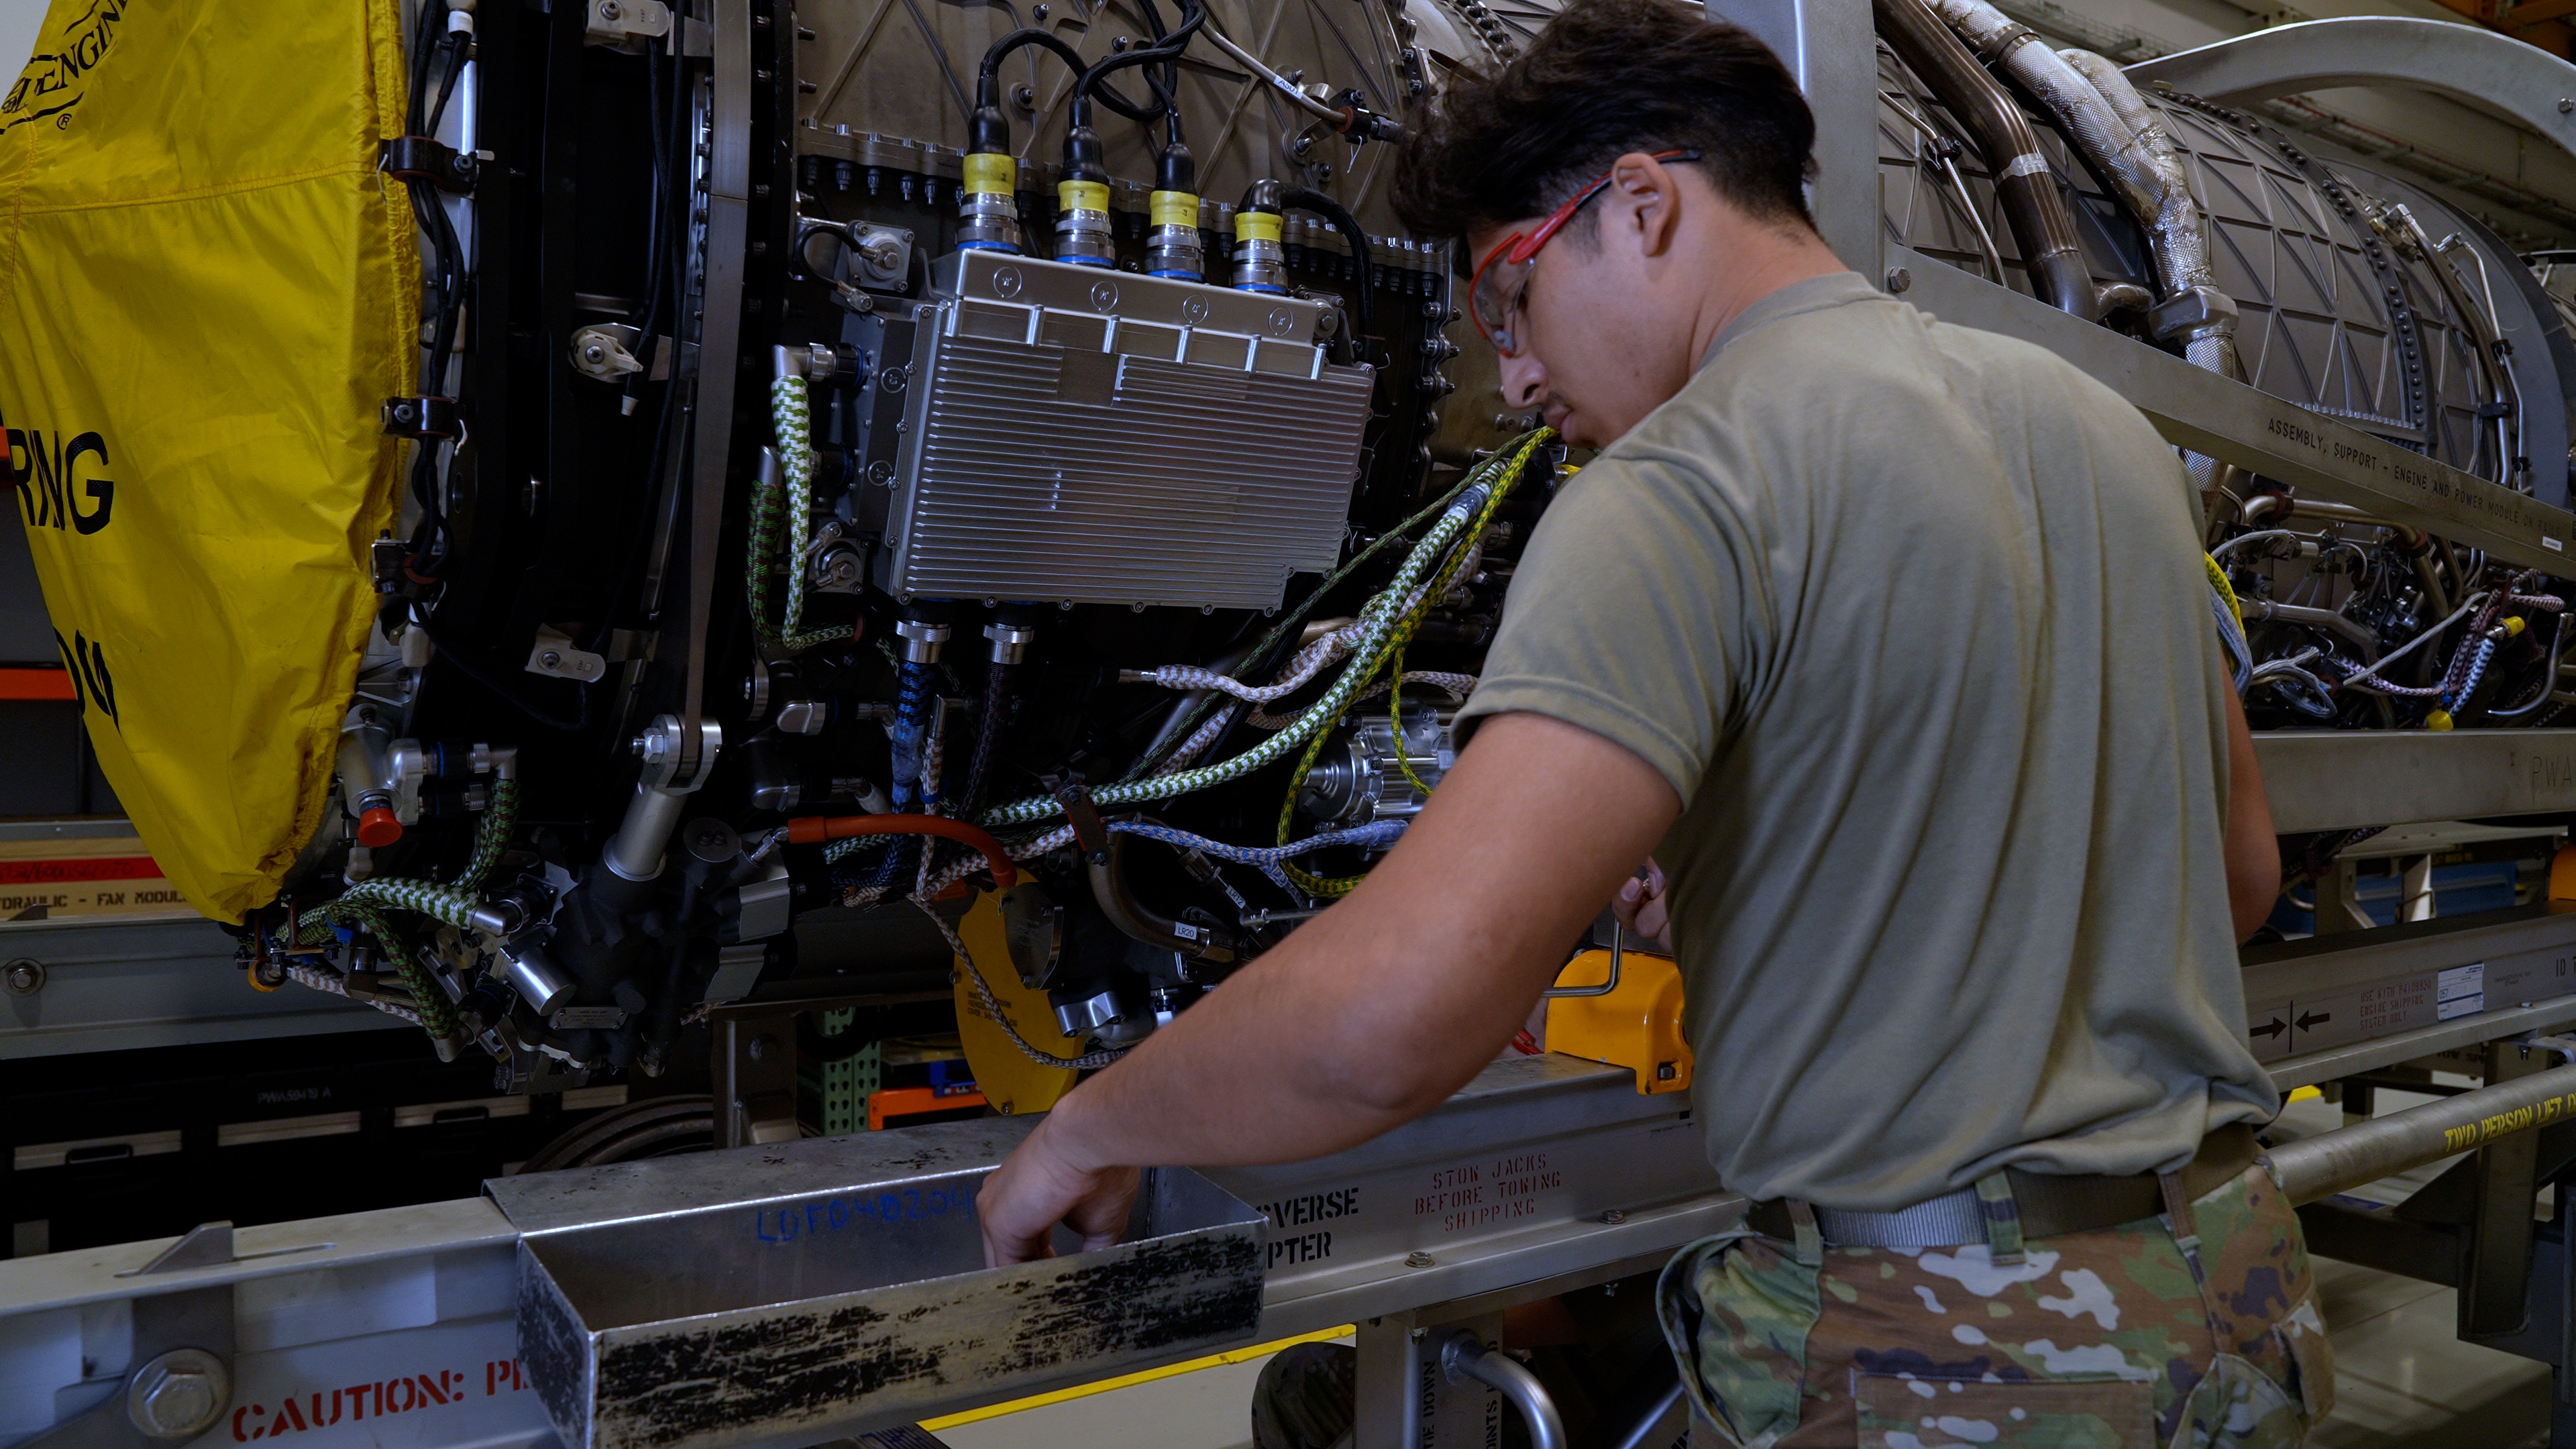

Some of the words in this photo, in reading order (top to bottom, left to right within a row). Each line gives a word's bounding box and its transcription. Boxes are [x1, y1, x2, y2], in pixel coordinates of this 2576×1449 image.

[34, 0, 129, 97] ENGIN
[2268, 417, 2327, 455] ASSEMBLY,
[2334, 442, 2377, 470] SUPPORT
[2394, 465, 2427, 490] ENGINE
[2432, 480, 2450, 498] AND
[2454, 488, 2483, 510] POWER
[2488, 501, 2519, 524] MODULE
[2523, 515, 2534, 528] ON
[0, 894, 68, 910] DRAULIC
[1229, 888, 1244, 906] LR12
[1177, 926, 1194, 938] LR20
[2390, 994, 2423, 1010] SHIPPING
[2444, 1123, 2477, 1152] TWO
[2480, 1105, 2534, 1142] PERSON
[2535, 1096, 2563, 1125] LIFT
[1492, 1153, 1546, 1178] JACKS
[1415, 1186, 1483, 1215] BEFORE
[1498, 1171, 1561, 1198] TOWING
[1444, 1198, 1535, 1232] SHIPPING
[233, 1369, 464, 1442] CAUTION:
[1422, 1360, 1436, 1418] DOWN
